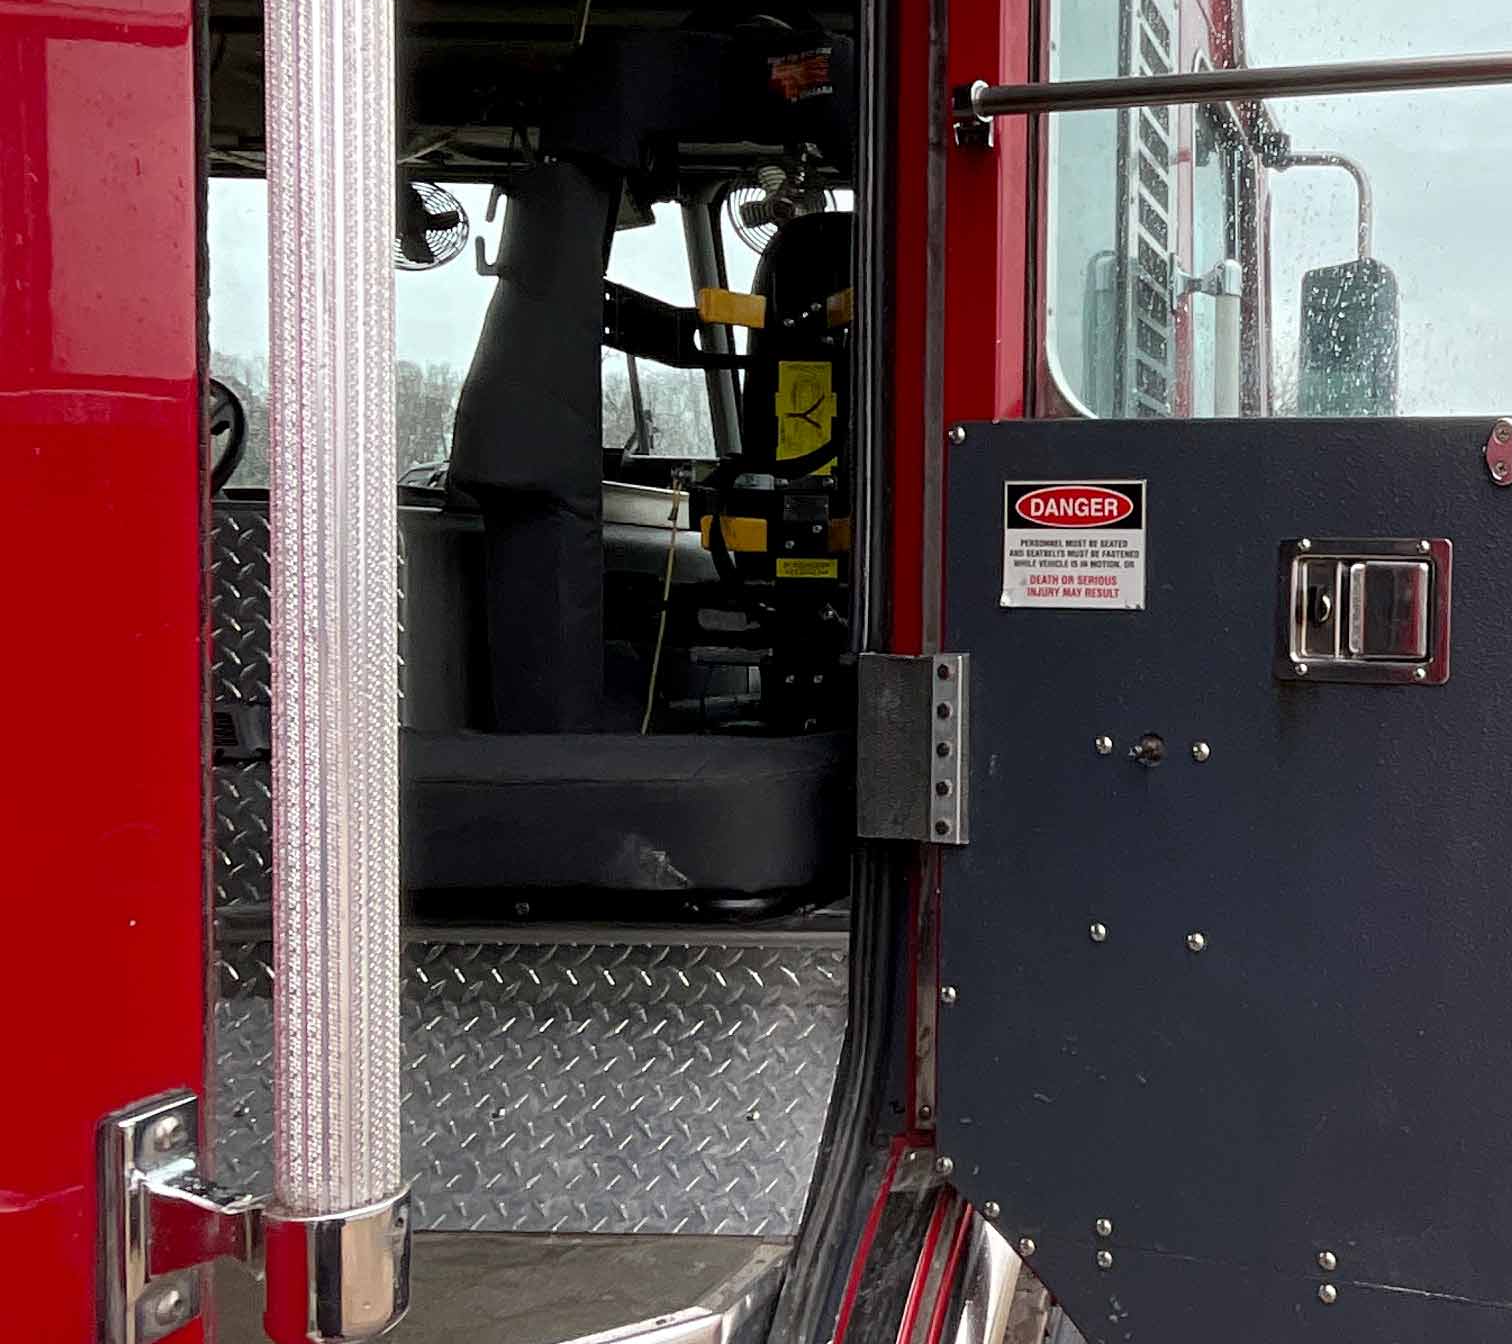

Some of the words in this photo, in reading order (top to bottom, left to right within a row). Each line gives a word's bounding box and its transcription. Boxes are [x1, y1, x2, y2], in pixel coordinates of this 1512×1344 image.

[1030, 498, 1119, 517] DANGER
[1020, 539, 1063, 548] PERSONNEL
[1065, 539, 1086, 548] MUST
[1089, 539, 1098, 548] BE
[1100, 539, 1128, 548] SEATED
[1009, 549, 1024, 557] AND
[1067, 549, 1088, 558] MUST
[1091, 550, 1099, 558] BE
[1102, 550, 1140, 558] FASTENED
[1013, 559, 1036, 567] WHILE
[1040, 559, 1068, 567] VEHICLE
[1070, 560, 1078, 568] IS
[1029, 575, 1059, 585] DEATH
[1061, 576, 1074, 585] OR
[1077, 576, 1118, 586] SERIOUS
[1026, 587, 1059, 597] INJURY
[1062, 587, 1082, 597] MAY
[1084, 588, 1120, 599] RESULT
